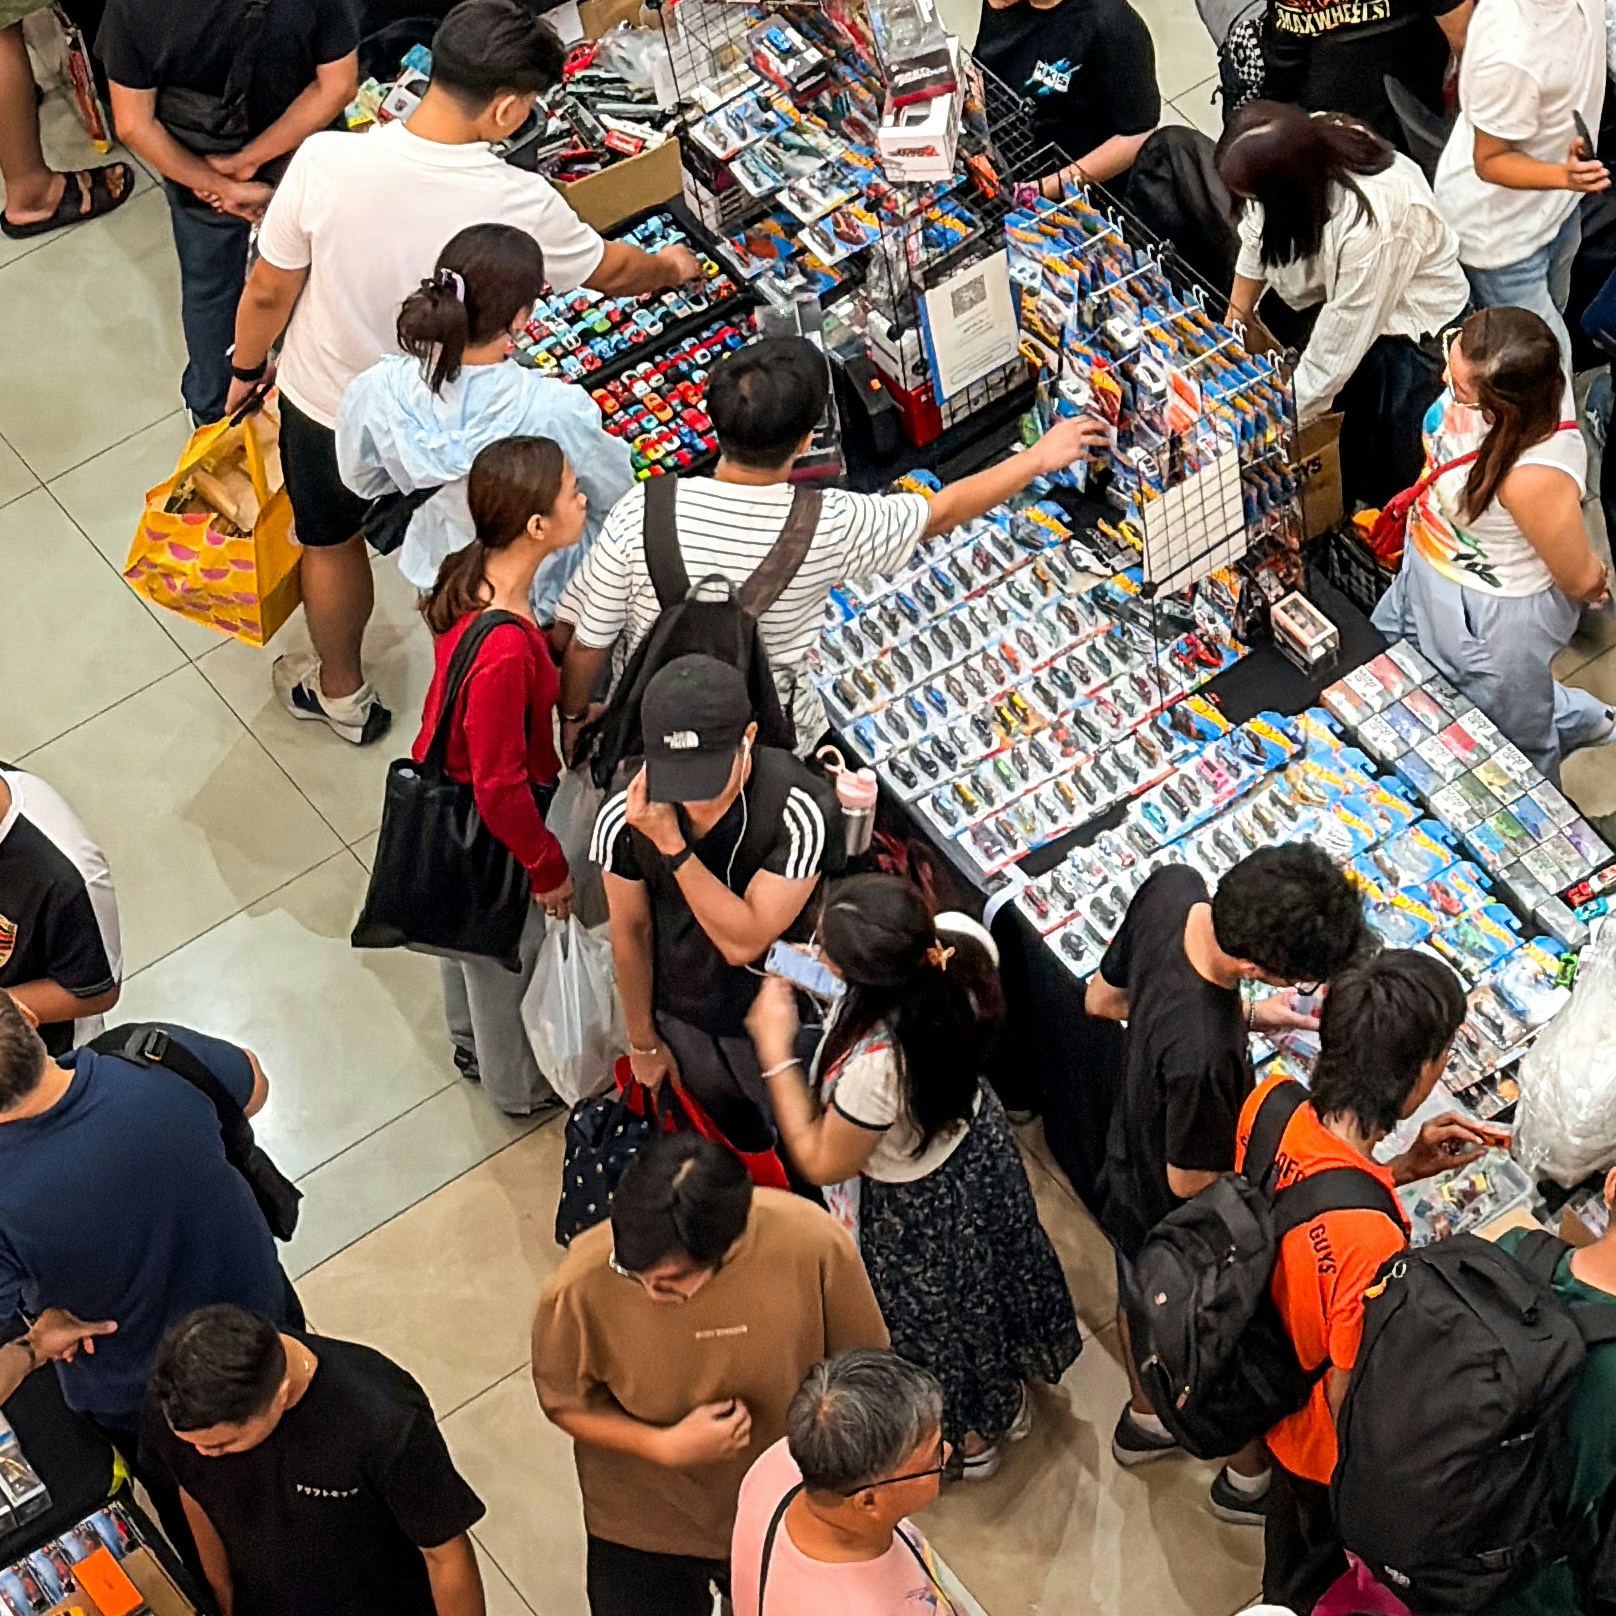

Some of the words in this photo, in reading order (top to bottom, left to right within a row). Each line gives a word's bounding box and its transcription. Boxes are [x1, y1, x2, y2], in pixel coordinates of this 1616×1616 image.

[1275, 1, 1387, 38] MAXWHEELS
[1033, 59, 1072, 93] HKS
[1309, 1223, 1337, 1275] GUYS
